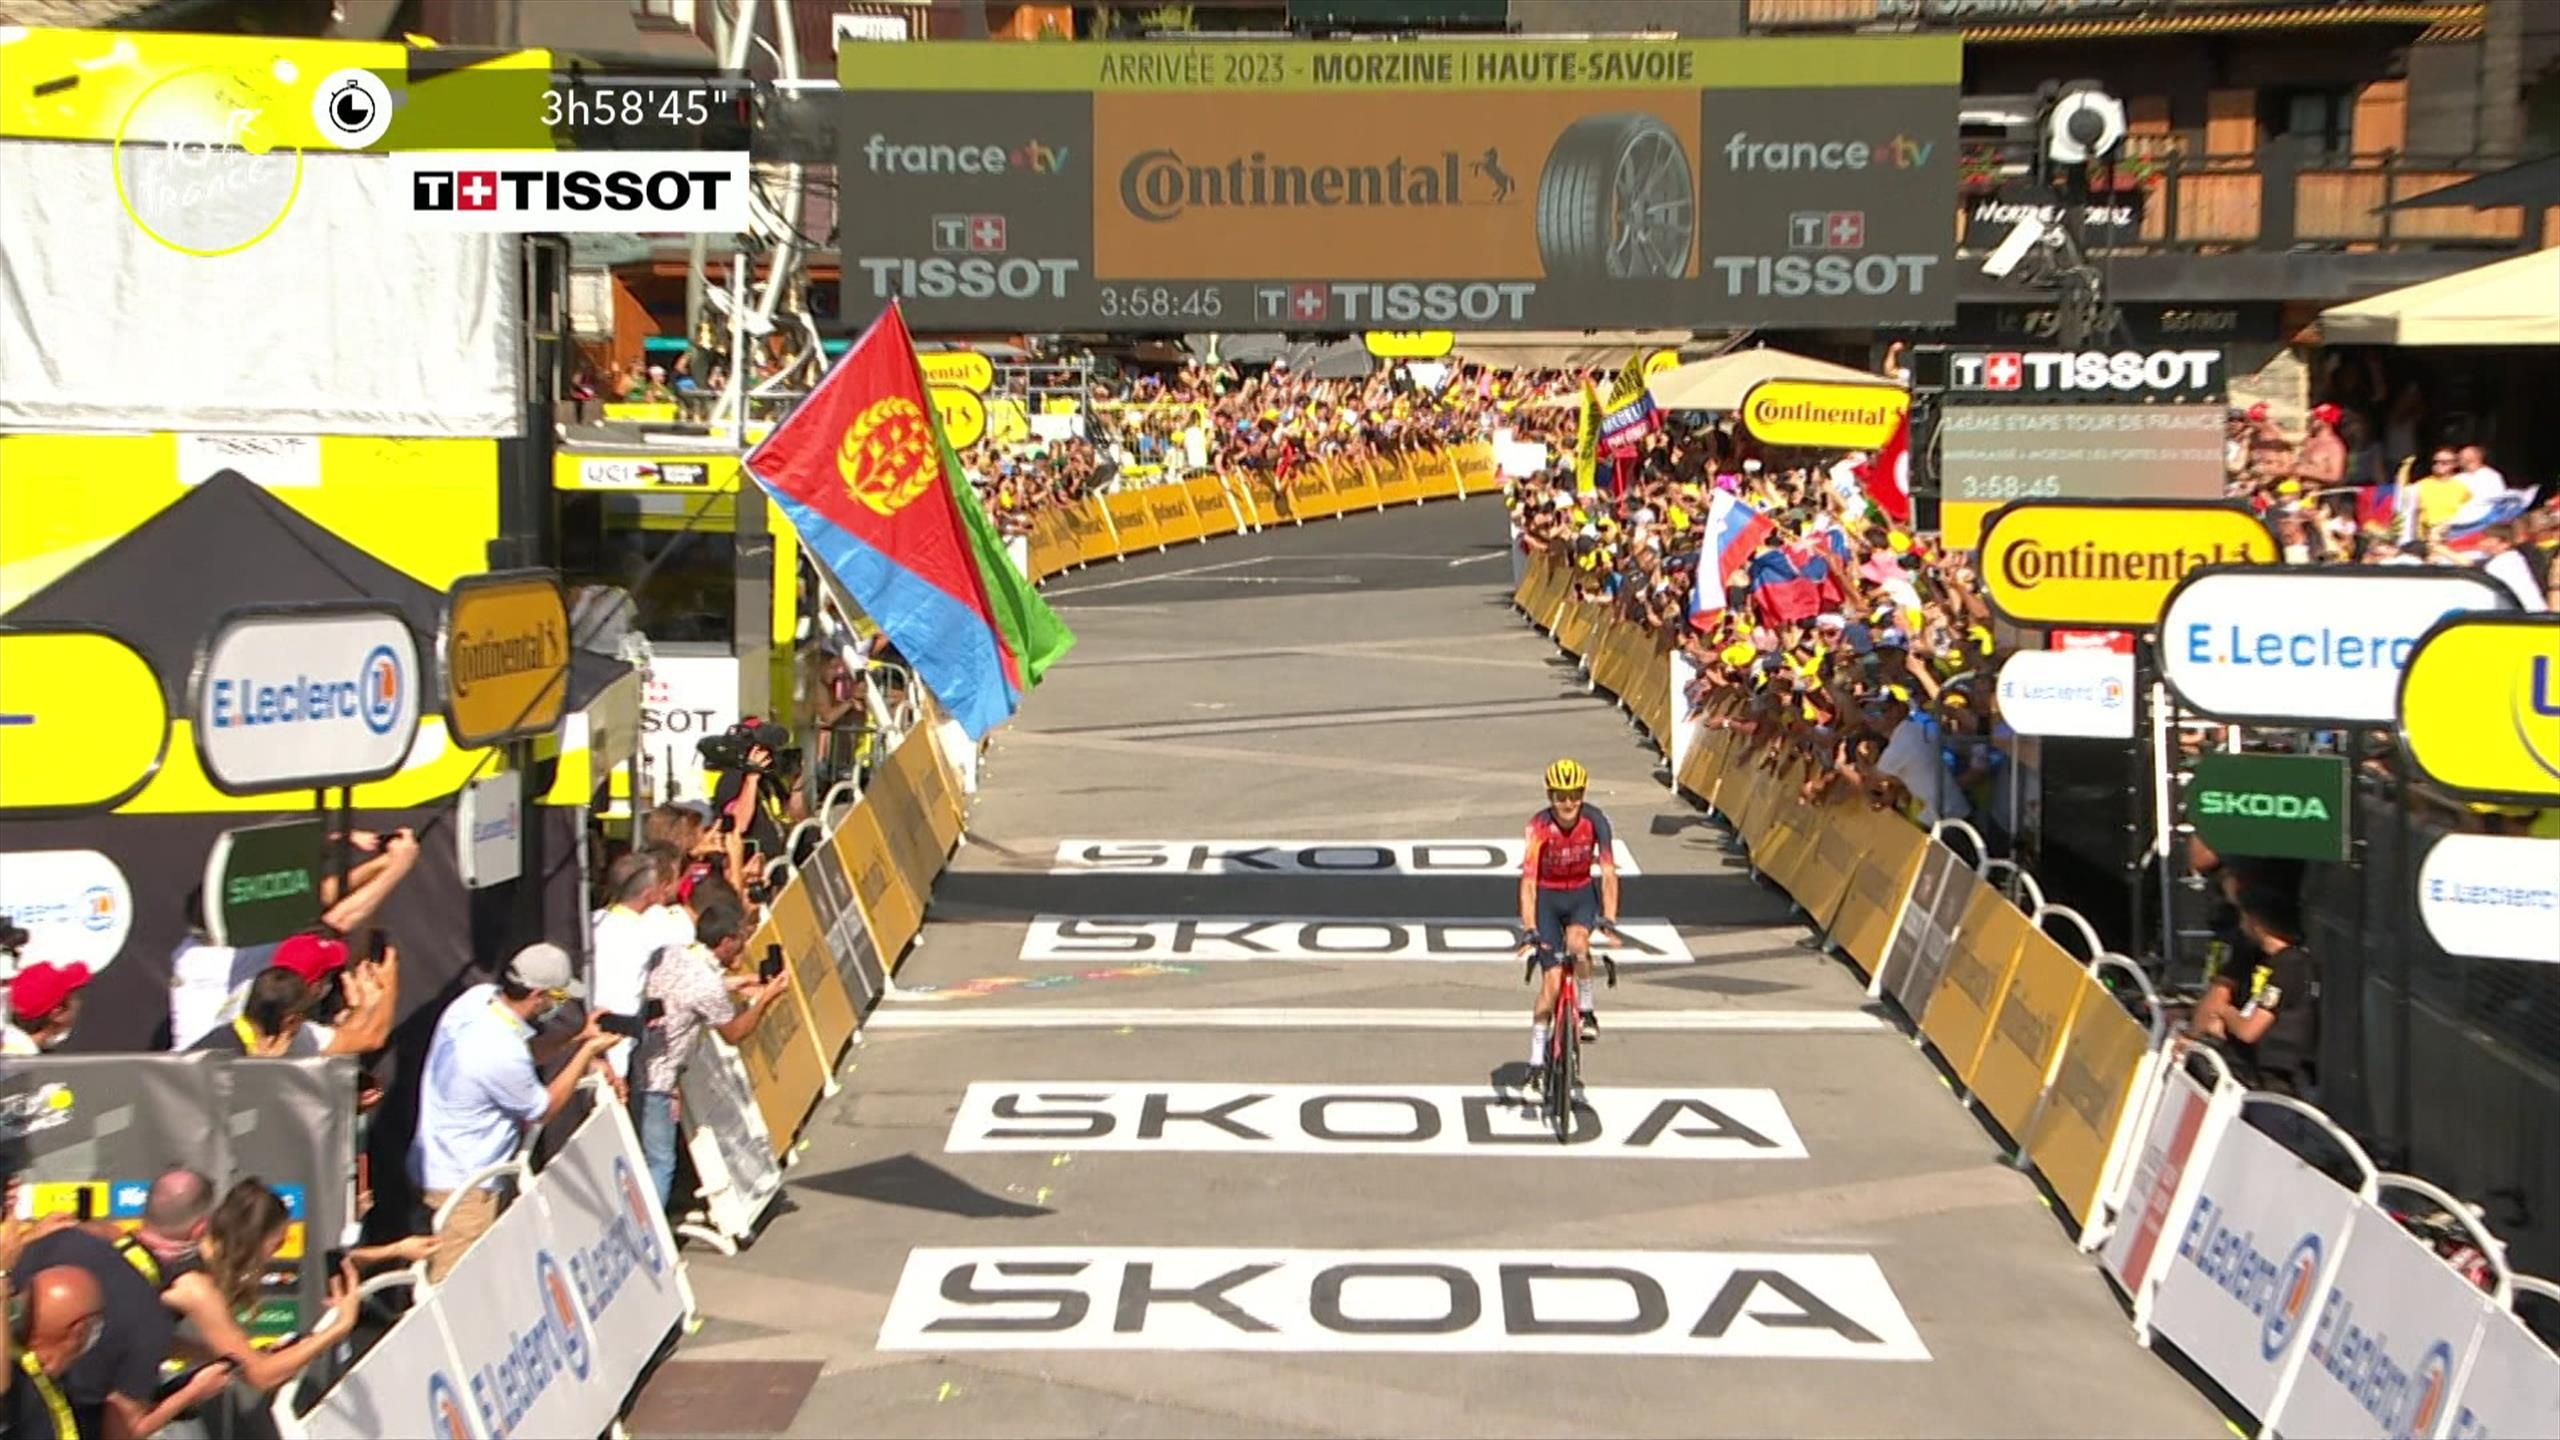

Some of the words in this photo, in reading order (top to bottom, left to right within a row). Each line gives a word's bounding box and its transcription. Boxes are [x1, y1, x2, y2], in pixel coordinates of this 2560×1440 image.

[1100, 42, 1215, 83] ARRIVÉE
[1224, 53, 1285, 82] 2023
[1312, 52, 1454, 82] MORZINE
[1476, 48, 1694, 81] HAUTE-SAVOIE
[1118, 148, 1462, 222] Continental
[858, 257, 1079, 299] TISSOT
[1713, 253, 1939, 297] TISSOT
[1099, 287, 1223, 316] 3:58:45
[1331, 283, 1536, 321] TISSOT
[923, 364, 970, 381] ental
[2023, 350, 2221, 390] TISSOT
[1755, 398, 1886, 427] Continental
[455, 620, 545, 698] Continental
[212, 673, 359, 729] E.Leclerc
[2199, 790, 2330, 821] SKODA
[980, 1091, 1785, 1149] SKODA
[919, 1260, 1888, 1346] SKODA
